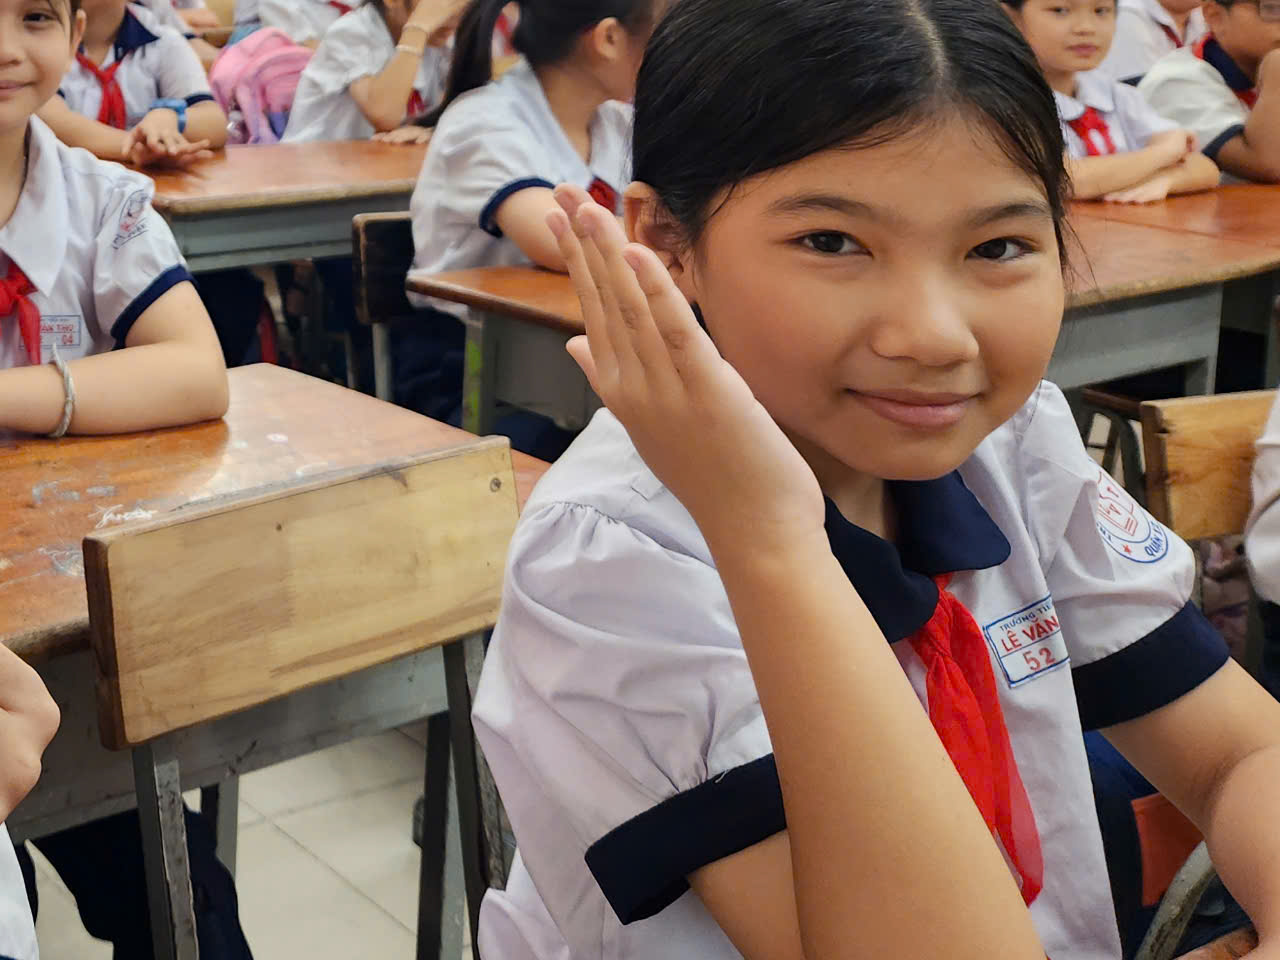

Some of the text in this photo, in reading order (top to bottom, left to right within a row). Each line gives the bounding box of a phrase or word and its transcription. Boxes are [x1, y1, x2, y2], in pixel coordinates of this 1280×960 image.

[1001, 615, 1060, 653] LÊ VĂN
[1022, 647, 1057, 672] 52
